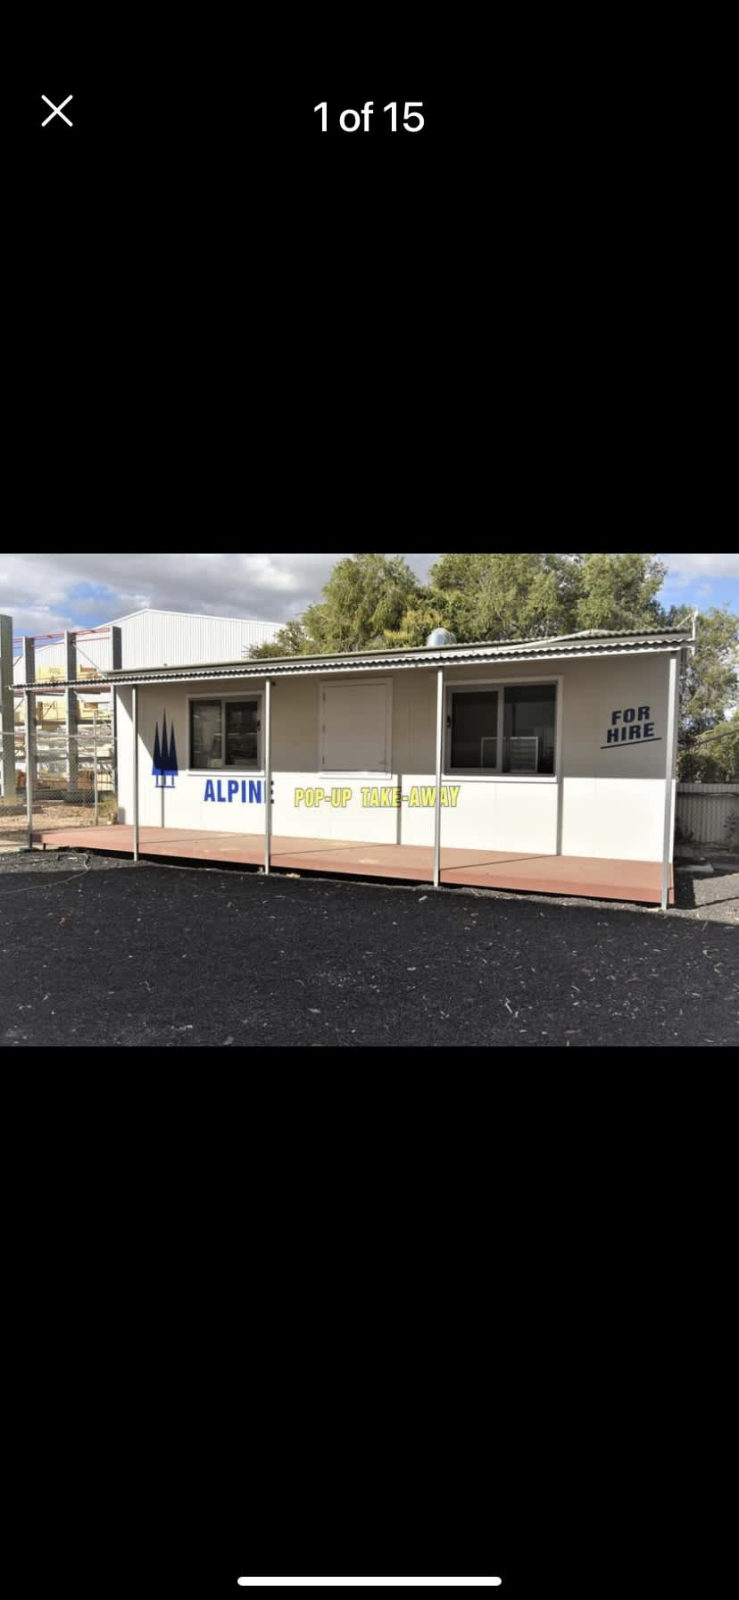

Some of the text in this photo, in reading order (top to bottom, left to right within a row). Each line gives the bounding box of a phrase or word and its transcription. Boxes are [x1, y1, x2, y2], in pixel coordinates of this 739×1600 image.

[611, 705, 650, 725] FOR
[606, 722, 655, 743] HIRE
[293, 785, 461, 808] POP-UP TAKE-AWAY
